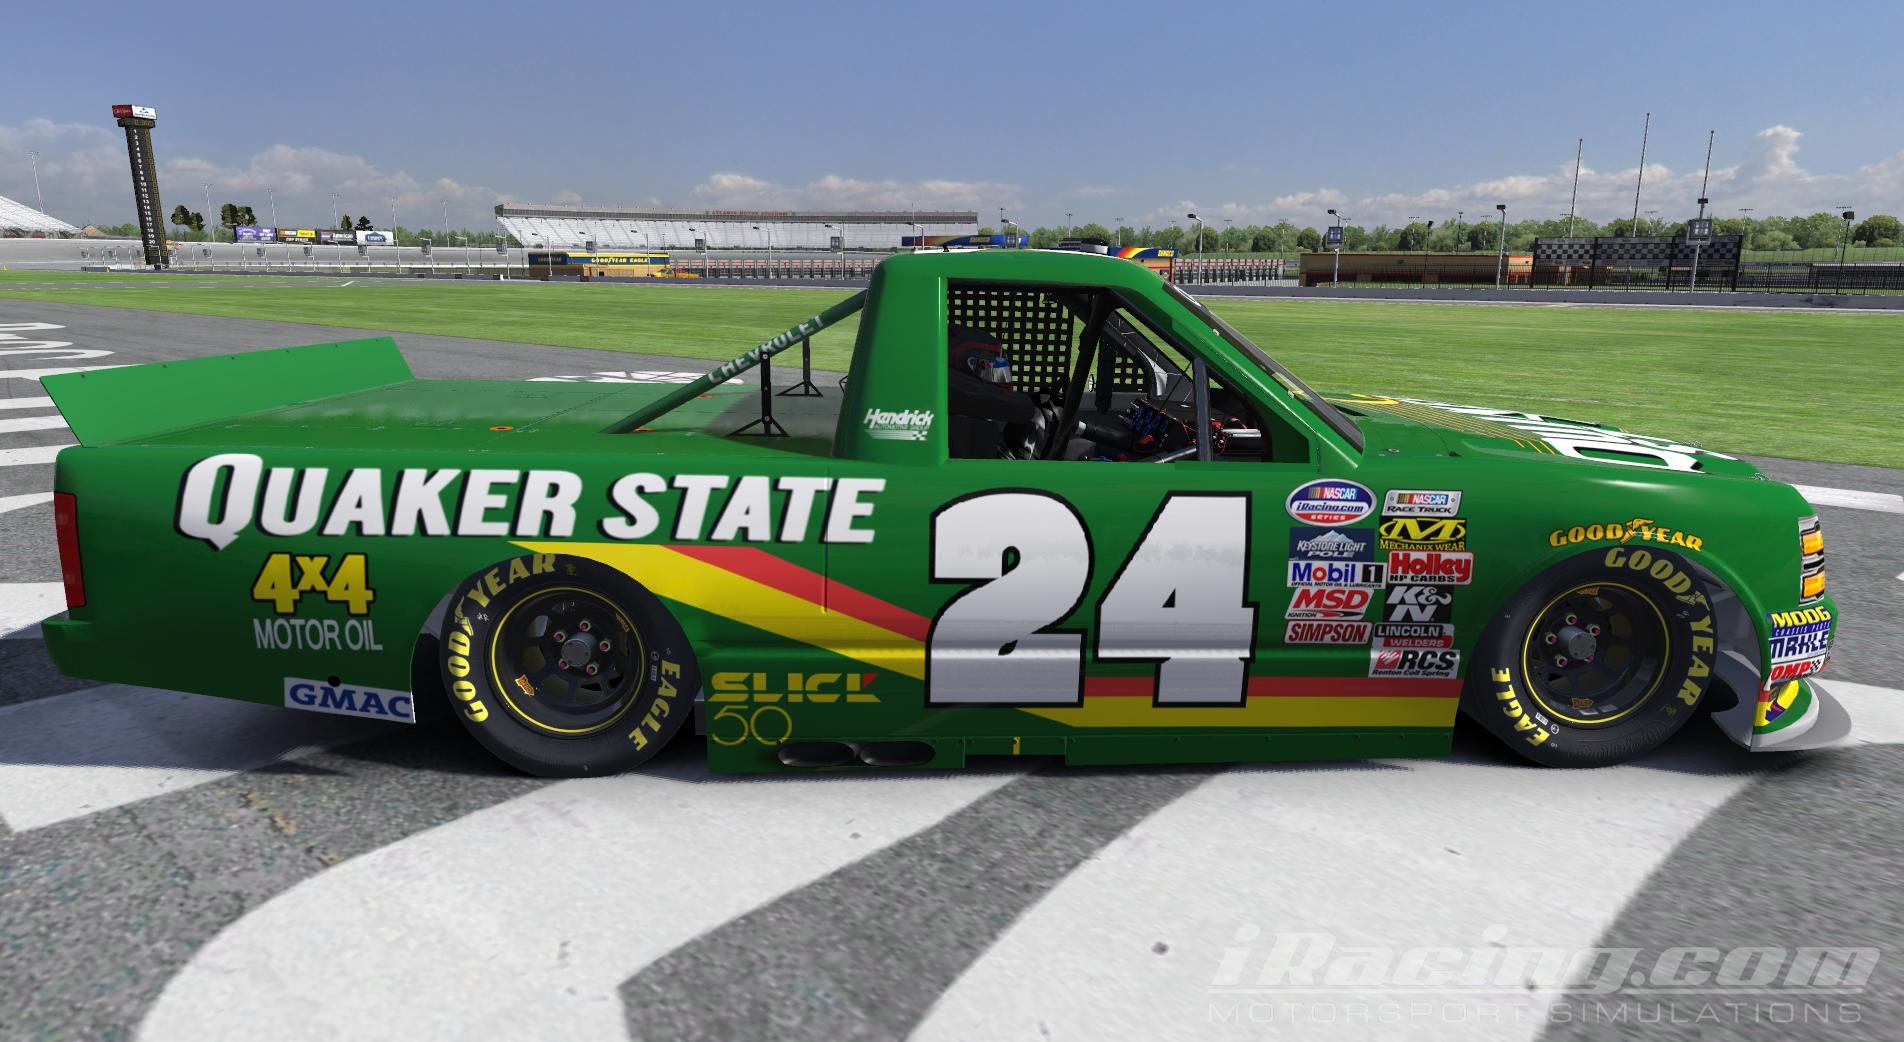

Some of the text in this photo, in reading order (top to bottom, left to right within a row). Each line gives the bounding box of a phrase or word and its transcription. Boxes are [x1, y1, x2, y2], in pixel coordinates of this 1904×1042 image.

[863, 408, 934, 429] Hendrick
[174, 453, 887, 550] QUAKER STATE
[1322, 487, 1357, 500] NASCAR
[1412, 494, 1448, 506] NASCAR
[1296, 502, 1364, 513] iRacing.com
[1418, 506, 1452, 514] TRUCK
[1380, 539, 1465, 551] MECHANIX WEAR
[1549, 518, 1703, 552] GOODYEAR
[1340, 542, 1367, 552] LIGHT
[1292, 562, 1357, 582] Mobil
[1391, 552, 1472, 583] Holley
[1411, 575, 1456, 583] CARBS
[924, 487, 1260, 708] 24
[1292, 588, 1370, 610] MSD
[1604, 547, 1714, 706] GOODYEAR
[1771, 605, 1832, 629] MOOG
[253, 618, 384, 651] MOTOR OIL
[448, 553, 556, 723] GOODYEAR
[1289, 623, 1368, 643] SIMPSON
[1377, 626, 1440, 636] LINCOLN
[1775, 625, 1809, 637] CHASSIS
[1390, 639, 1445, 647] WELDERS
[1769, 630, 1829, 659] MAHLE
[1397, 650, 1457, 670] RCS
[708, 671, 882, 703] SLICK
[289, 682, 412, 719] GMAC
[627, 659, 681, 752] EAGLE
[1490, 666, 1551, 748] EAGLE
[711, 704, 793, 746] 50
